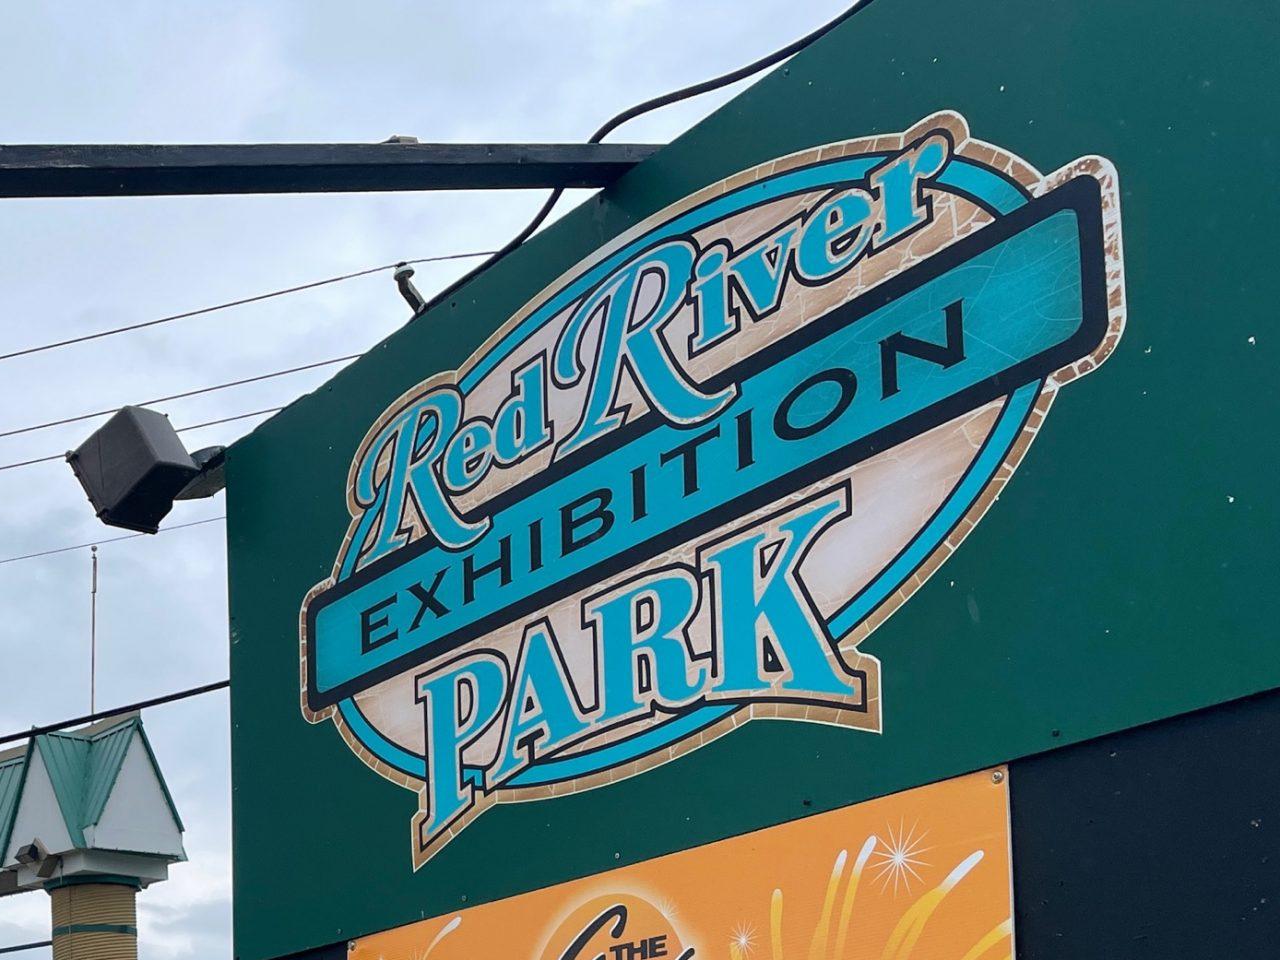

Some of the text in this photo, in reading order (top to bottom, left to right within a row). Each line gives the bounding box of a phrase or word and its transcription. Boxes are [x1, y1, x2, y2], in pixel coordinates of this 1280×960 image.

[354, 136, 951, 569] Red River
[359, 300, 968, 656] EXHIBITION
[416, 490, 861, 842] PARK
